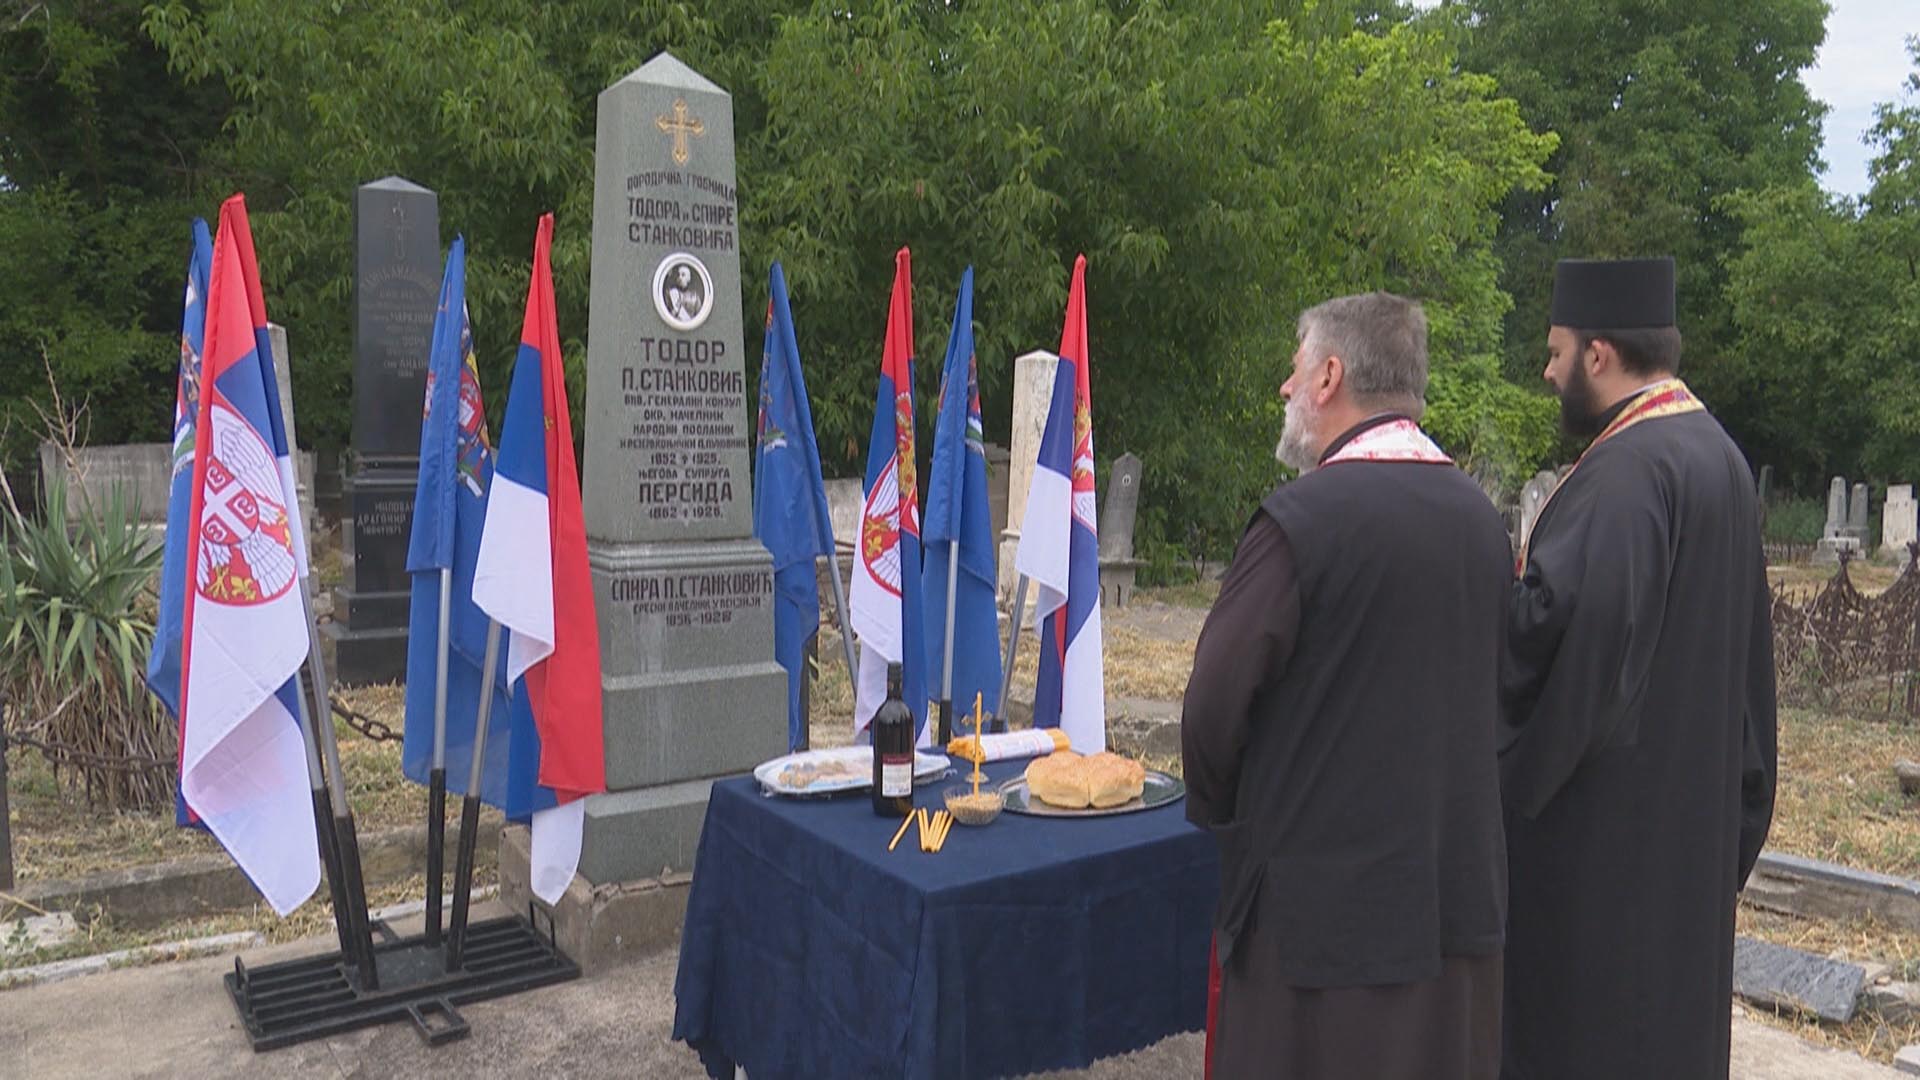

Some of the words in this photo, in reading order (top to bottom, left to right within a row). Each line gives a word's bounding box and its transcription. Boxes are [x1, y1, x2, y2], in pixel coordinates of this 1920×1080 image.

[627, 197, 680, 220] ТОДОРА
[692, 203, 734, 225] СПИРЕ
[628, 222, 734, 251] СТАНКОВИЋА
[640, 338, 725, 367] ТОДОР
[705, 396, 740, 409] КОНЗУЛ
[643, 409, 666, 421] ОКР.
[670, 410, 724, 421] НАЧЕЛНИК
[633, 424, 678, 436] НАРОДНИ
[682, 424, 734, 436] ПОСЛАНИК
[638, 468, 678, 480] ЊЕГОВА
[685, 468, 730, 480] СУПРУГА
[639, 483, 733, 504] ПЕРСИДА
[611, 578, 660, 601] СПИРА
